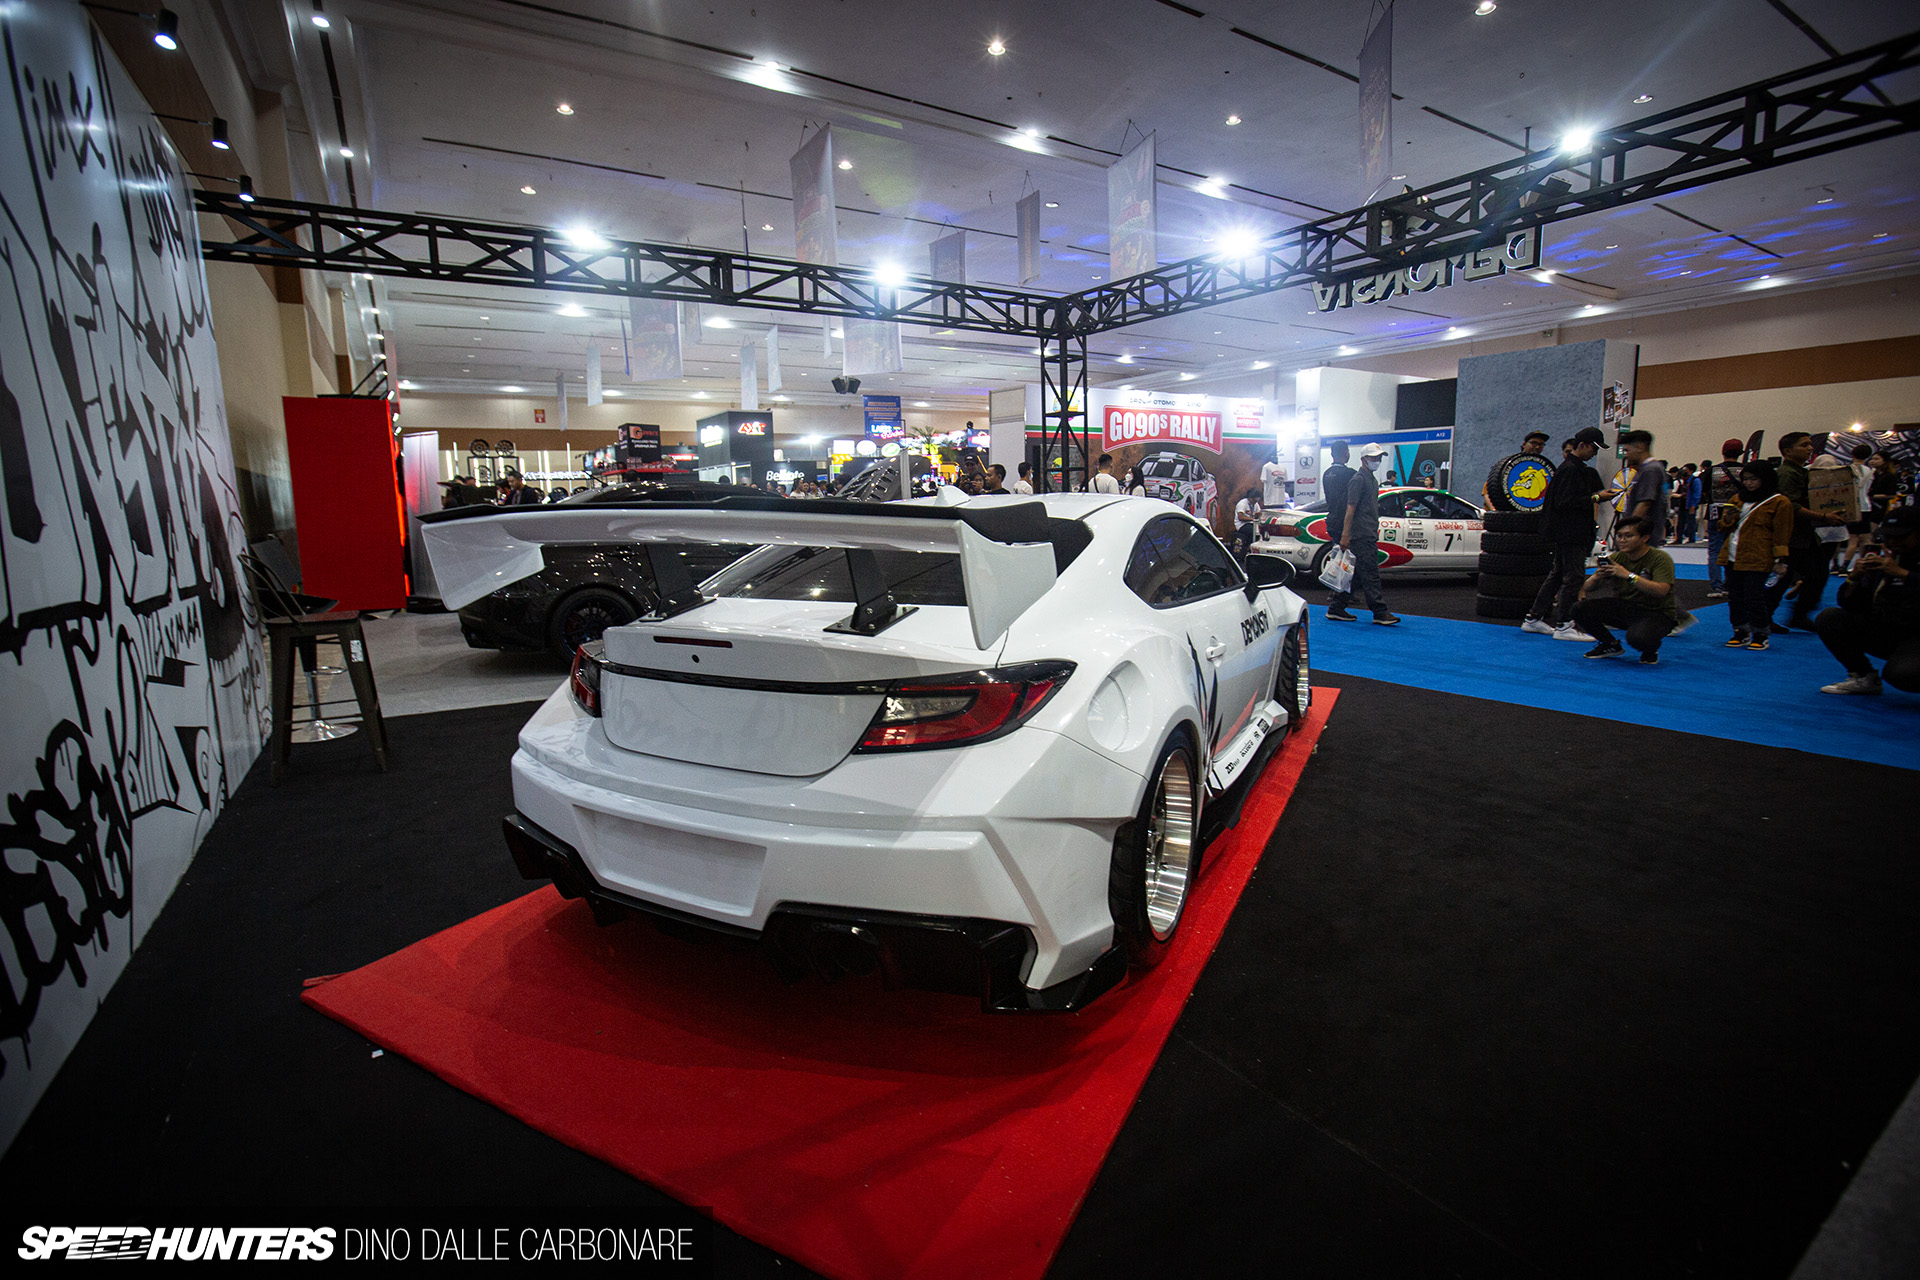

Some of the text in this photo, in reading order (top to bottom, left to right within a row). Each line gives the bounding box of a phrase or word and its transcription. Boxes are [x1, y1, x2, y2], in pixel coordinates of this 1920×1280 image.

[1170, 414, 1217, 445] RALLY
[1444, 533, 1454, 552] 7
[1456, 533, 1463, 541] A
